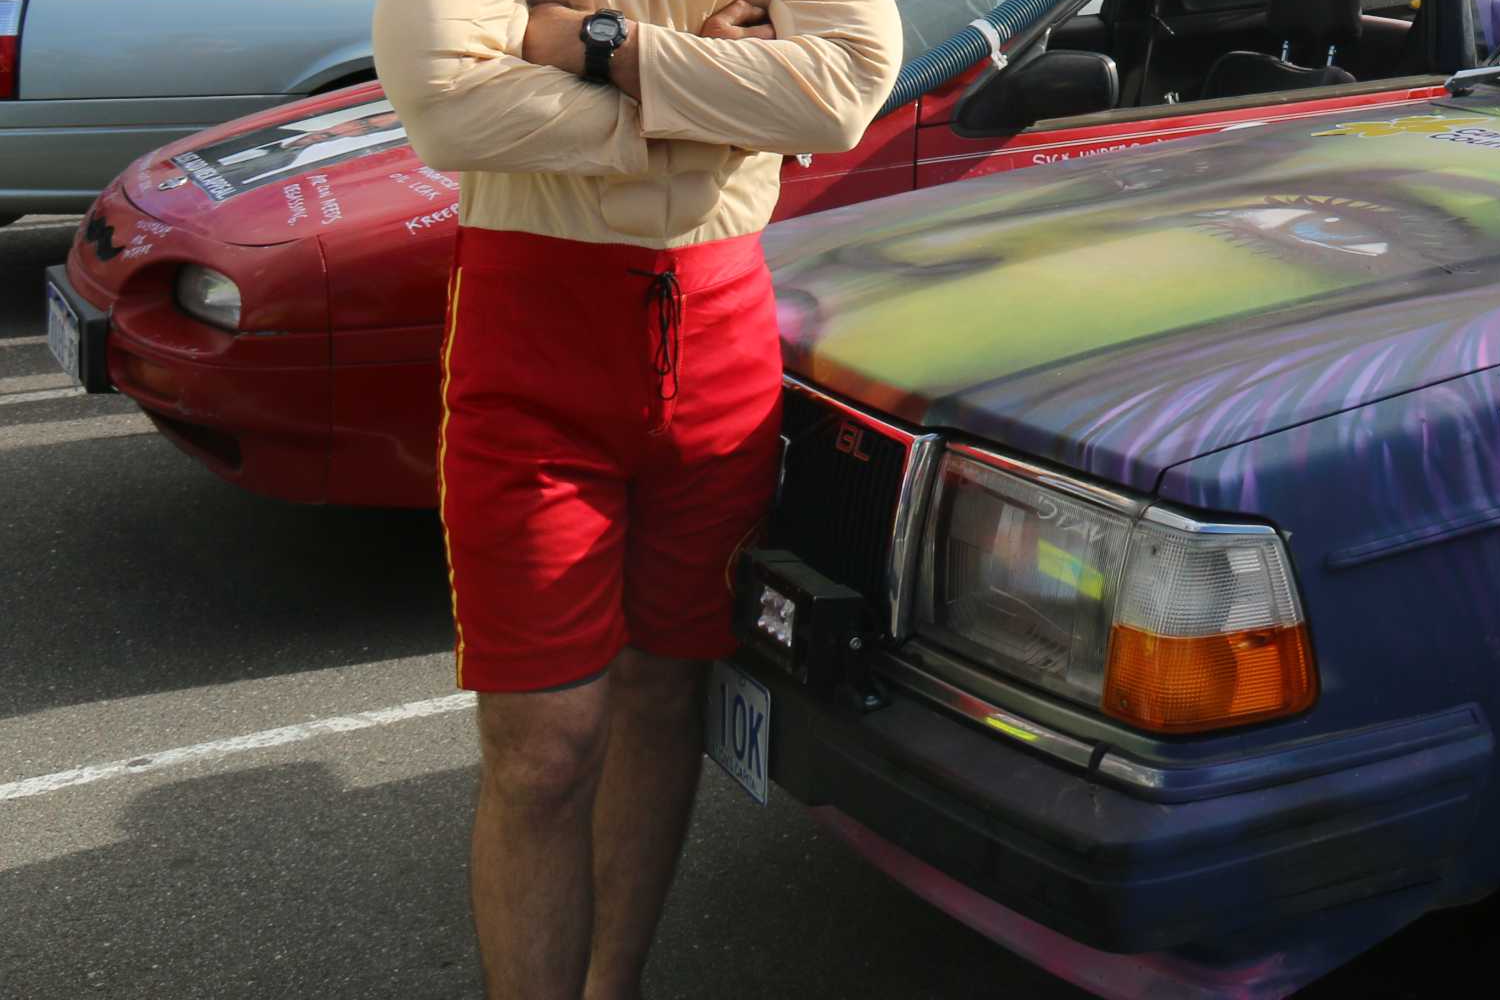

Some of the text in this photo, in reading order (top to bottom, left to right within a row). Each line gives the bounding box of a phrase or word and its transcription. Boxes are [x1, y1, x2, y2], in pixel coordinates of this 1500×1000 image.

[409, 181, 440, 201] LEAK
[320, 198, 344, 225] NEEDS
[835, 421, 869, 461] GL
